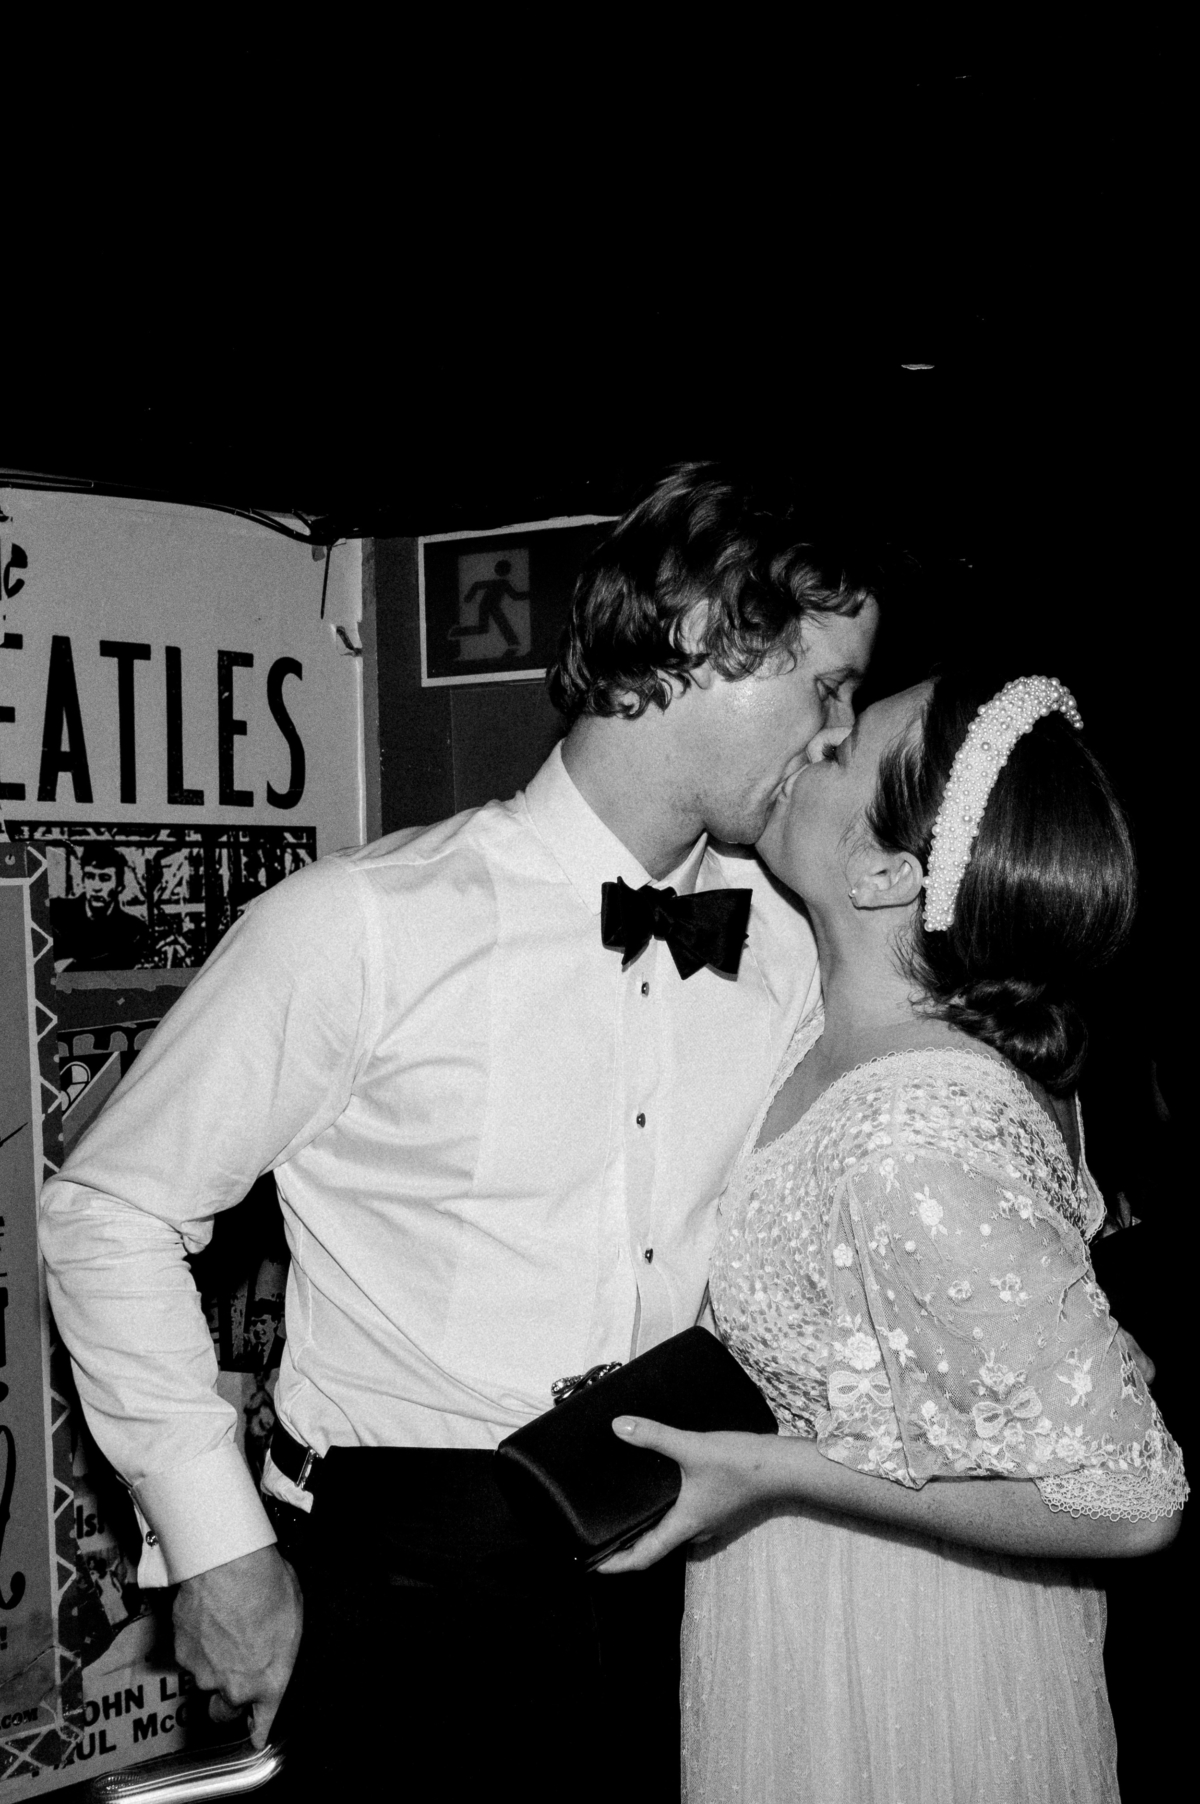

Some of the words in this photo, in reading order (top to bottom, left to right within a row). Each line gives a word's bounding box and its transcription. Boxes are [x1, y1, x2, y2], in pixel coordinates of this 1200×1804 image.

[83, 1685, 144, 1727] OHN
[160, 1671, 197, 1702] LE
[133, 1702, 189, 1743] McC
